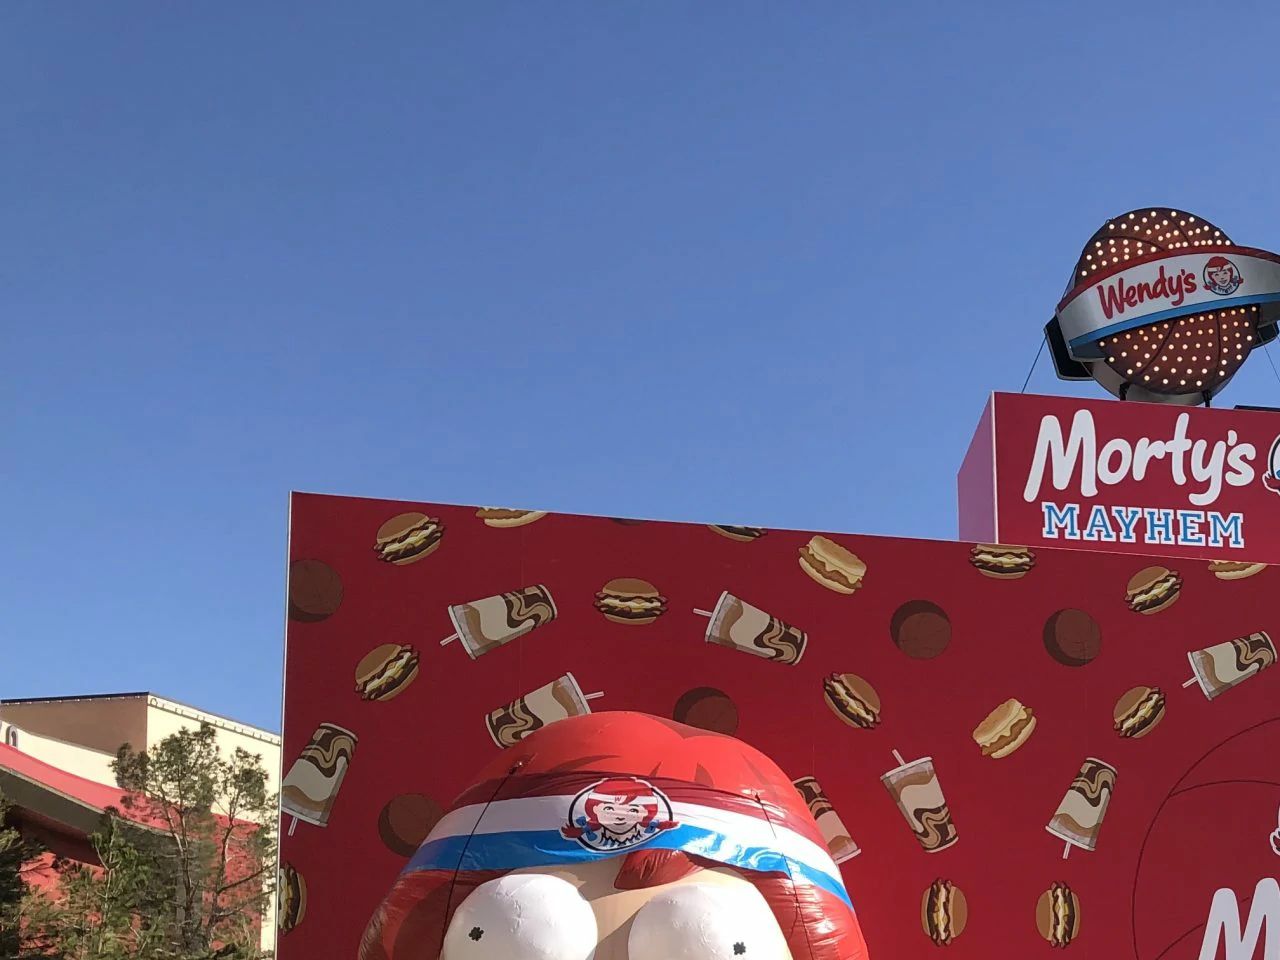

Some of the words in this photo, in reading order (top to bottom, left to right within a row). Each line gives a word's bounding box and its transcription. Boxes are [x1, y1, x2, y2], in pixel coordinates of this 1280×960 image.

[1097, 265, 1198, 320] Wendy's
[1023, 408, 1256, 506] Morty's
[1041, 501, 1245, 549] MAYHEM
